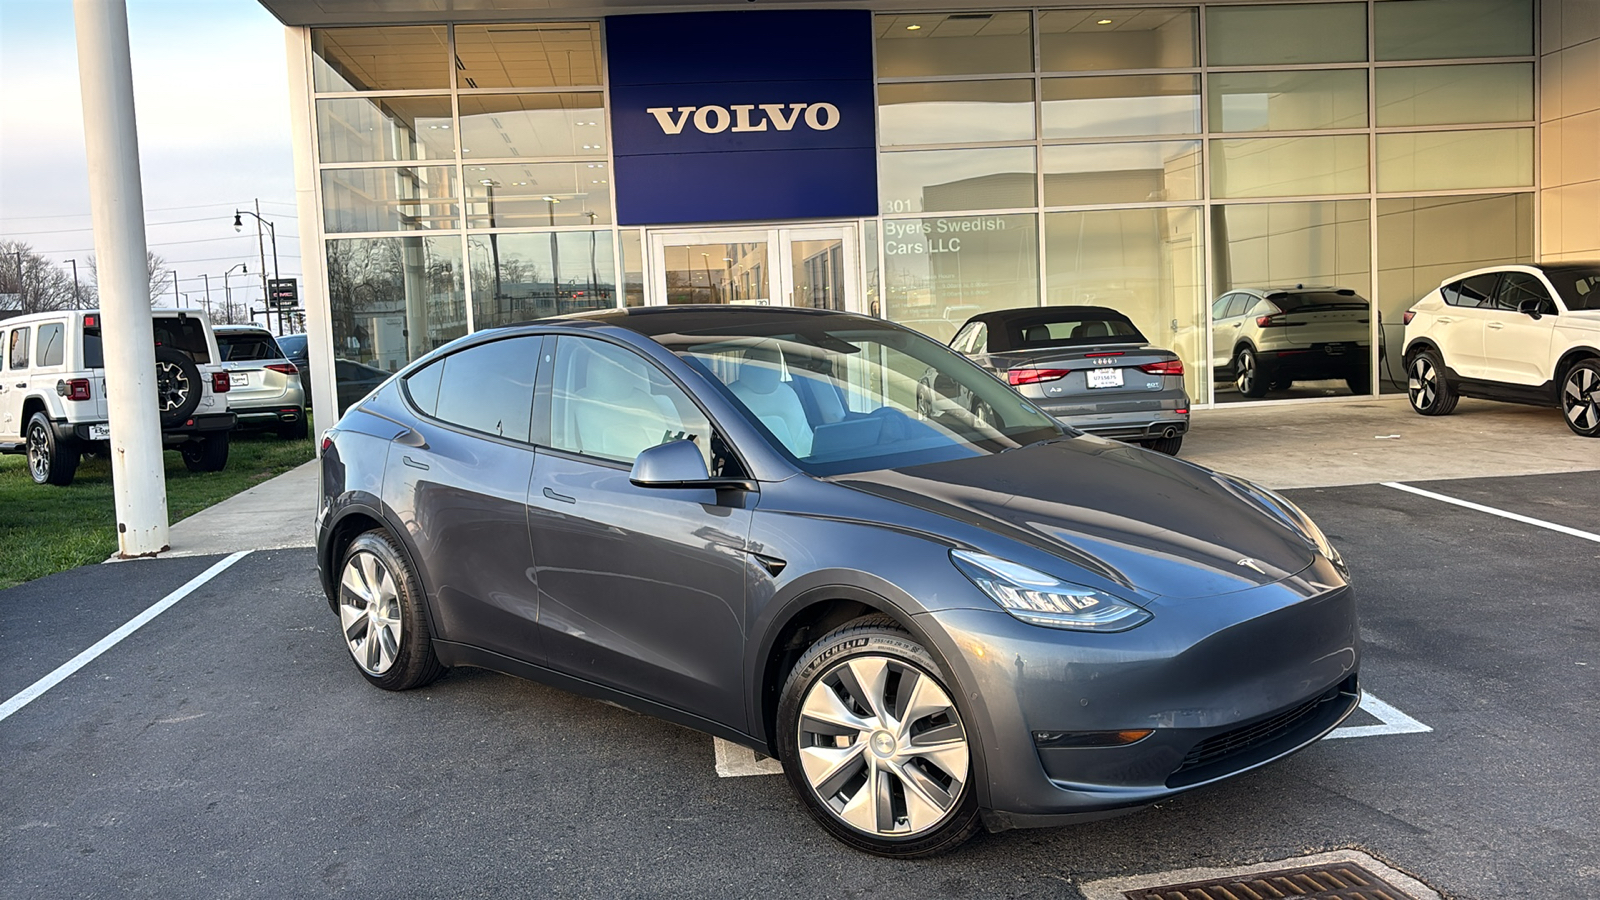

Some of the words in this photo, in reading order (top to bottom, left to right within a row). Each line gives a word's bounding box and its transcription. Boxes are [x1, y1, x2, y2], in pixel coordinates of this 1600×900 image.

[646, 102, 841, 135] VOLVO
[885, 199, 912, 213] 301
[885, 221, 932, 239] Byers
[937, 217, 1006, 233] Swedish
[885, 241, 923, 256] Cars
[929, 238, 961, 253] LLC
[813, 638, 866, 667] MICHELIN
